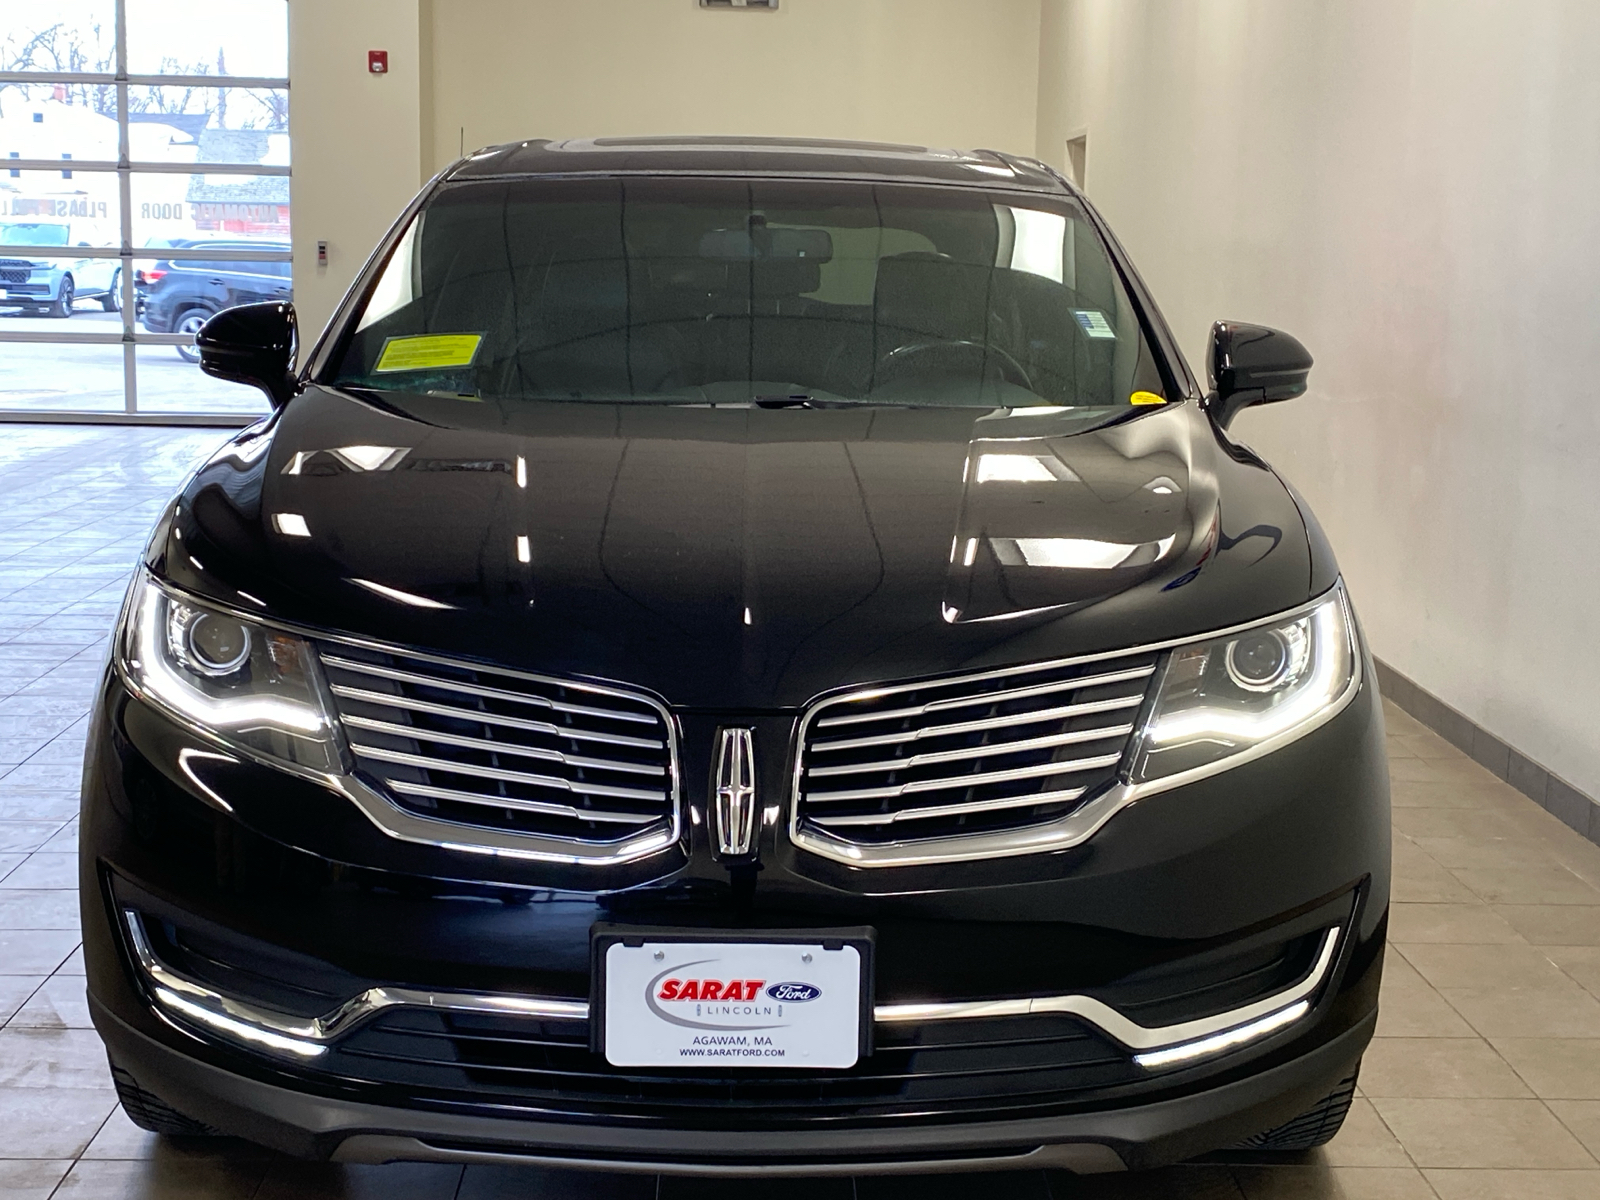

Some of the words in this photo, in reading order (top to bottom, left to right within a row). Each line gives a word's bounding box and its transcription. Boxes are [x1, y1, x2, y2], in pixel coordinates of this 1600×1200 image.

[657, 978, 767, 1003] SARAT
[775, 985, 811, 1000] Ford
[707, 1006, 772, 1015] LINCOLN
[692, 1036, 751, 1047] AGAWAM,
[754, 1036, 773, 1047] MA
[680, 1048, 786, 1057] WWW.SARATFORD.COM
